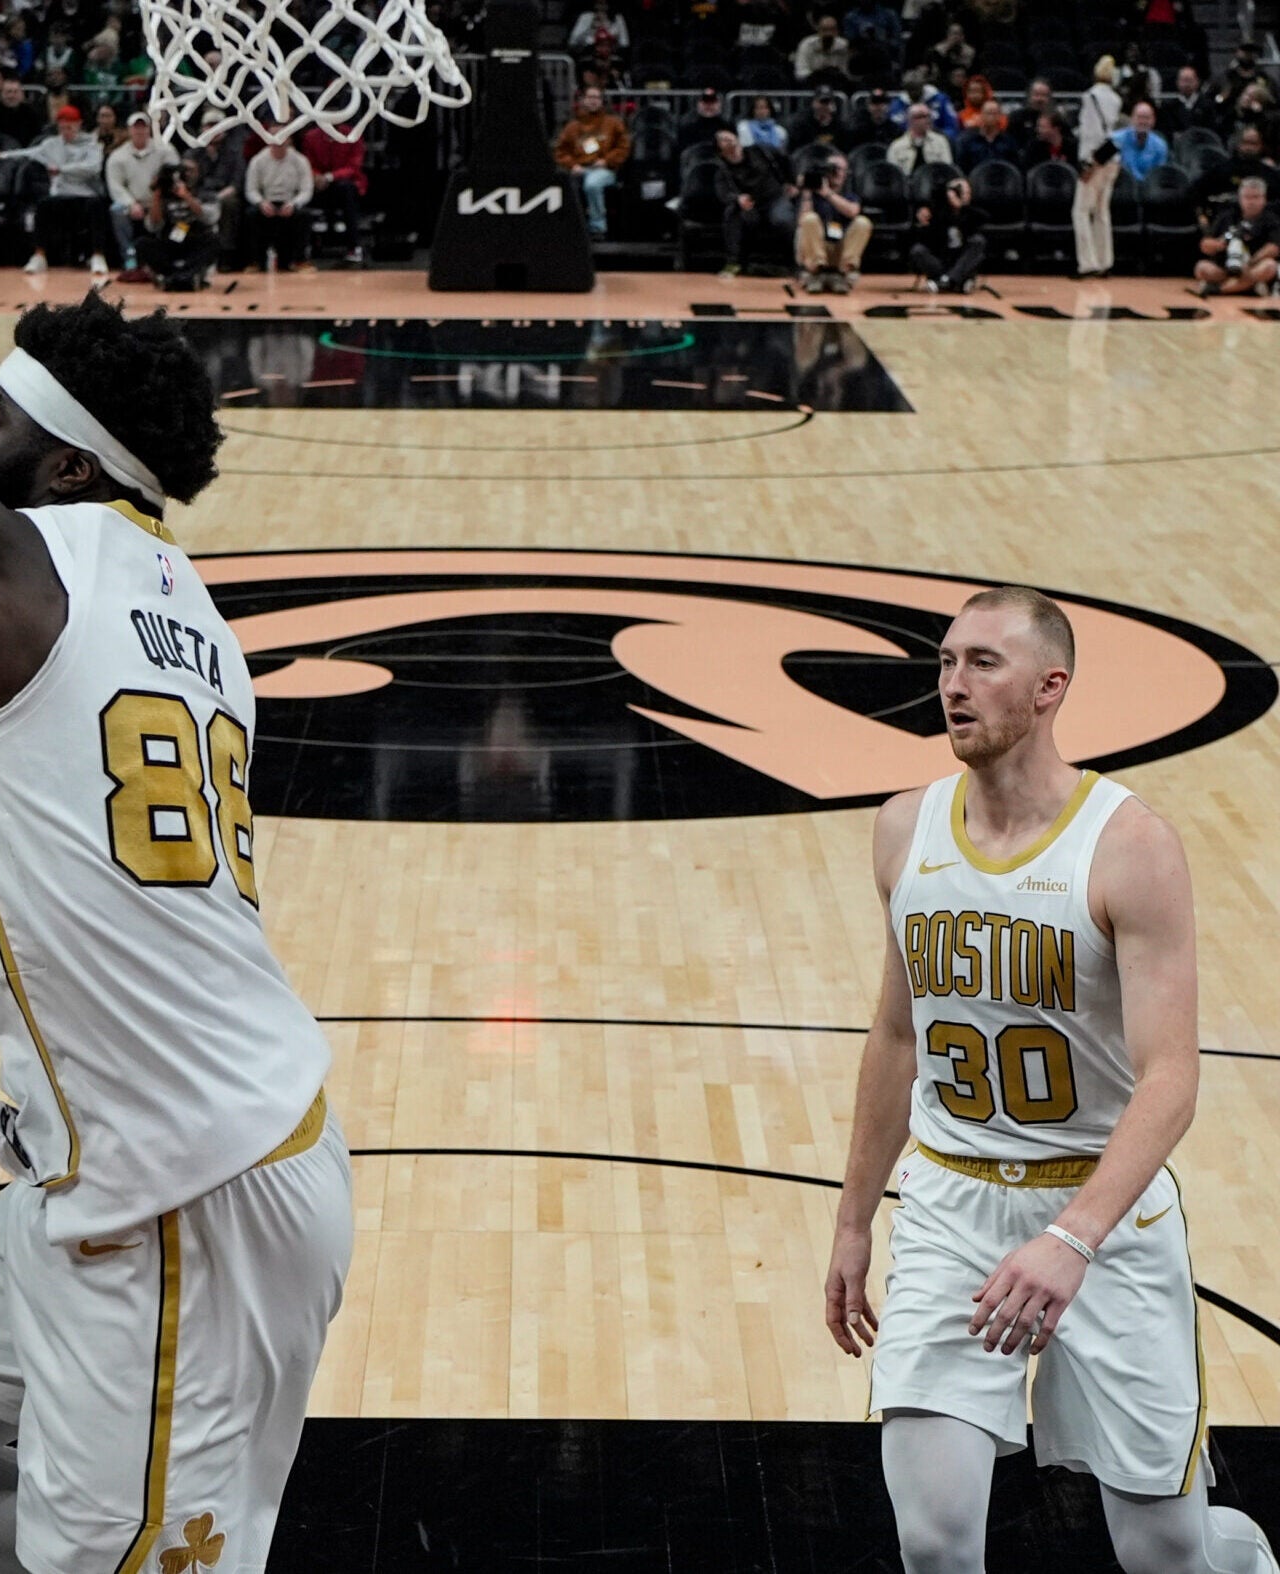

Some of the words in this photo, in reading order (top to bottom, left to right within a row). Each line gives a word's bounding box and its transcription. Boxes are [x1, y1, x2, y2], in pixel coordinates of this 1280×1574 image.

[458, 186, 563, 214] KIA
[130, 609, 224, 696] QUETA
[99, 688, 259, 912] 88
[1016, 875, 1068, 892] Amica
[905, 910, 1076, 1012] BOSTON
[926, 1020, 1078, 1125] 30
